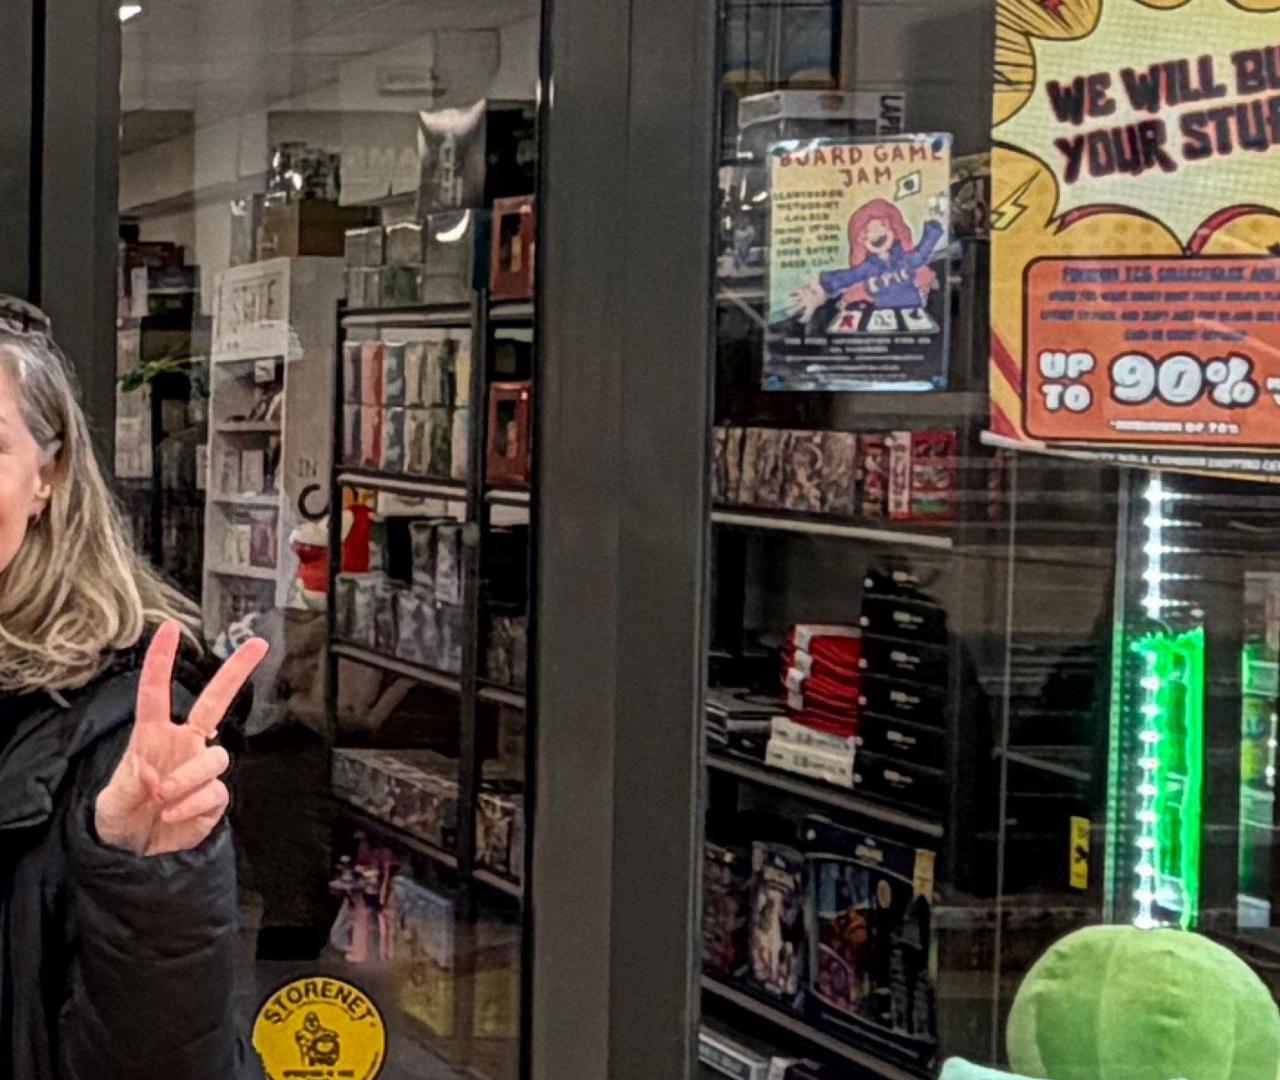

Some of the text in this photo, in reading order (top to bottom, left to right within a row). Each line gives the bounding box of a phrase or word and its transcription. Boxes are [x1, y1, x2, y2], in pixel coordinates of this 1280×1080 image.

[1045, 71, 1117, 126] WE
[1120, 54, 1228, 114] WILL
[873, 144, 943, 164] GAME
[1053, 118, 1179, 184] YOUR
[839, 166, 892, 188] JAM
[1038, 350, 1259, 406] UP 90%
[1040, 383, 1091, 412] TO
[263, 980, 376, 1024] STORENET
